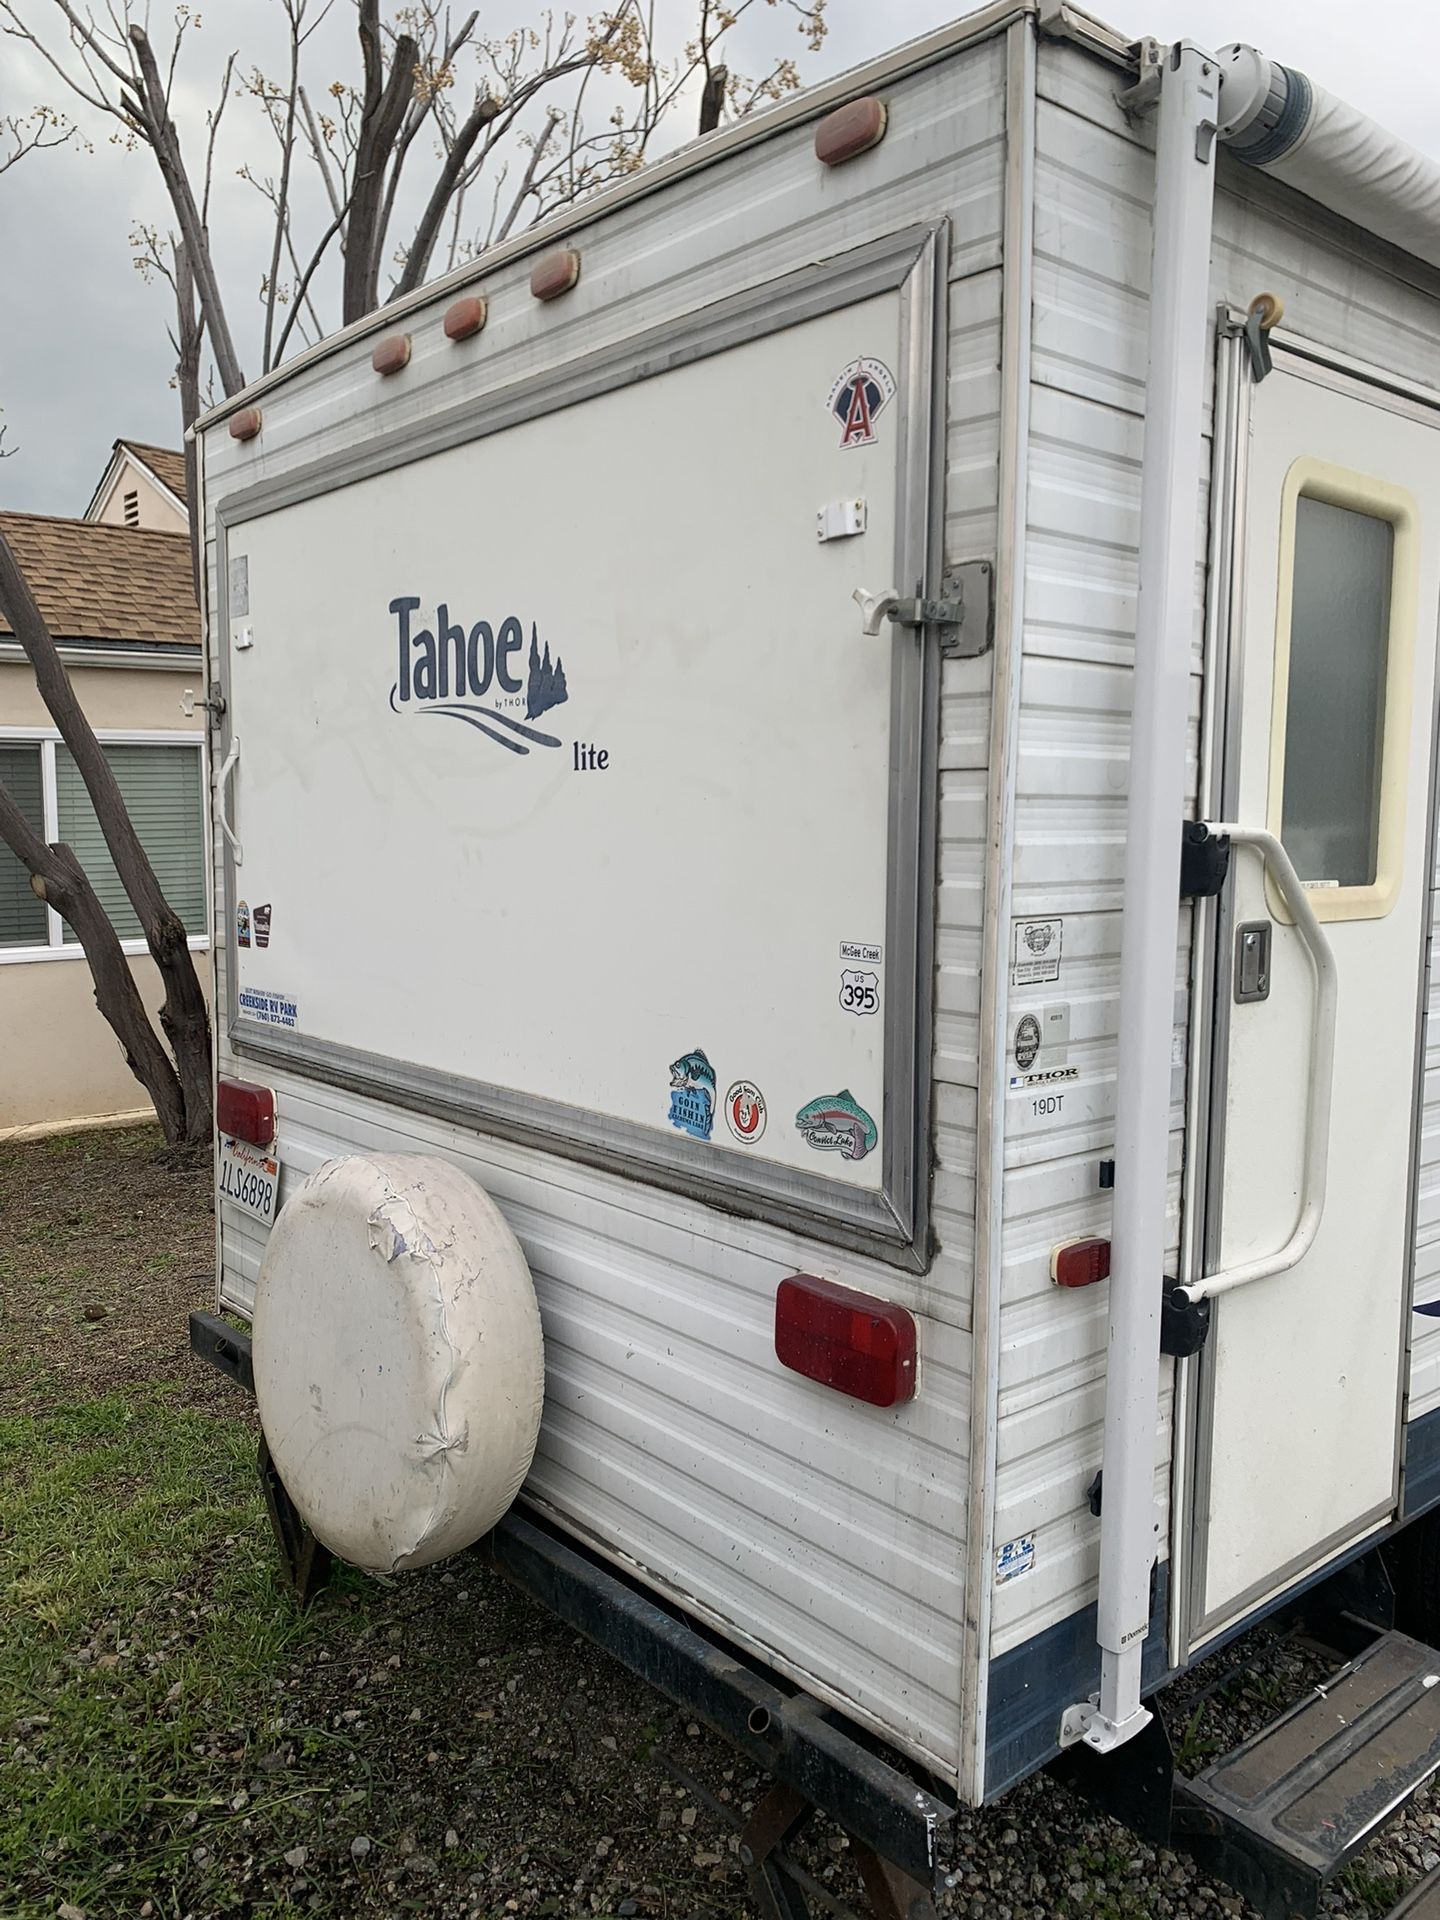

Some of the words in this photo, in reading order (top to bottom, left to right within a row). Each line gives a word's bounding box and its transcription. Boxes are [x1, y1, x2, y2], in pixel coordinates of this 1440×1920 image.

[840, 377, 875, 447] A
[389, 597, 523, 702] Tahoe
[573, 741, 609, 771] lite
[842, 944, 861, 957] McGee
[863, 947, 880, 960] Creek
[854, 974, 865, 984] US
[240, 993, 269, 1012] CREEKSIDE
[269, 999, 279, 1014] RV
[280, 1001, 298, 1018] PARK
[844, 984, 875, 1009] 395
[1024, 1068, 1078, 1083] THOR
[1032, 1094, 1065, 1116] 19DT
[809, 1131, 833, 1145] Convict
[834, 1133, 854, 1147] Lake
[219, 1160, 273, 1215] 1LS6898
